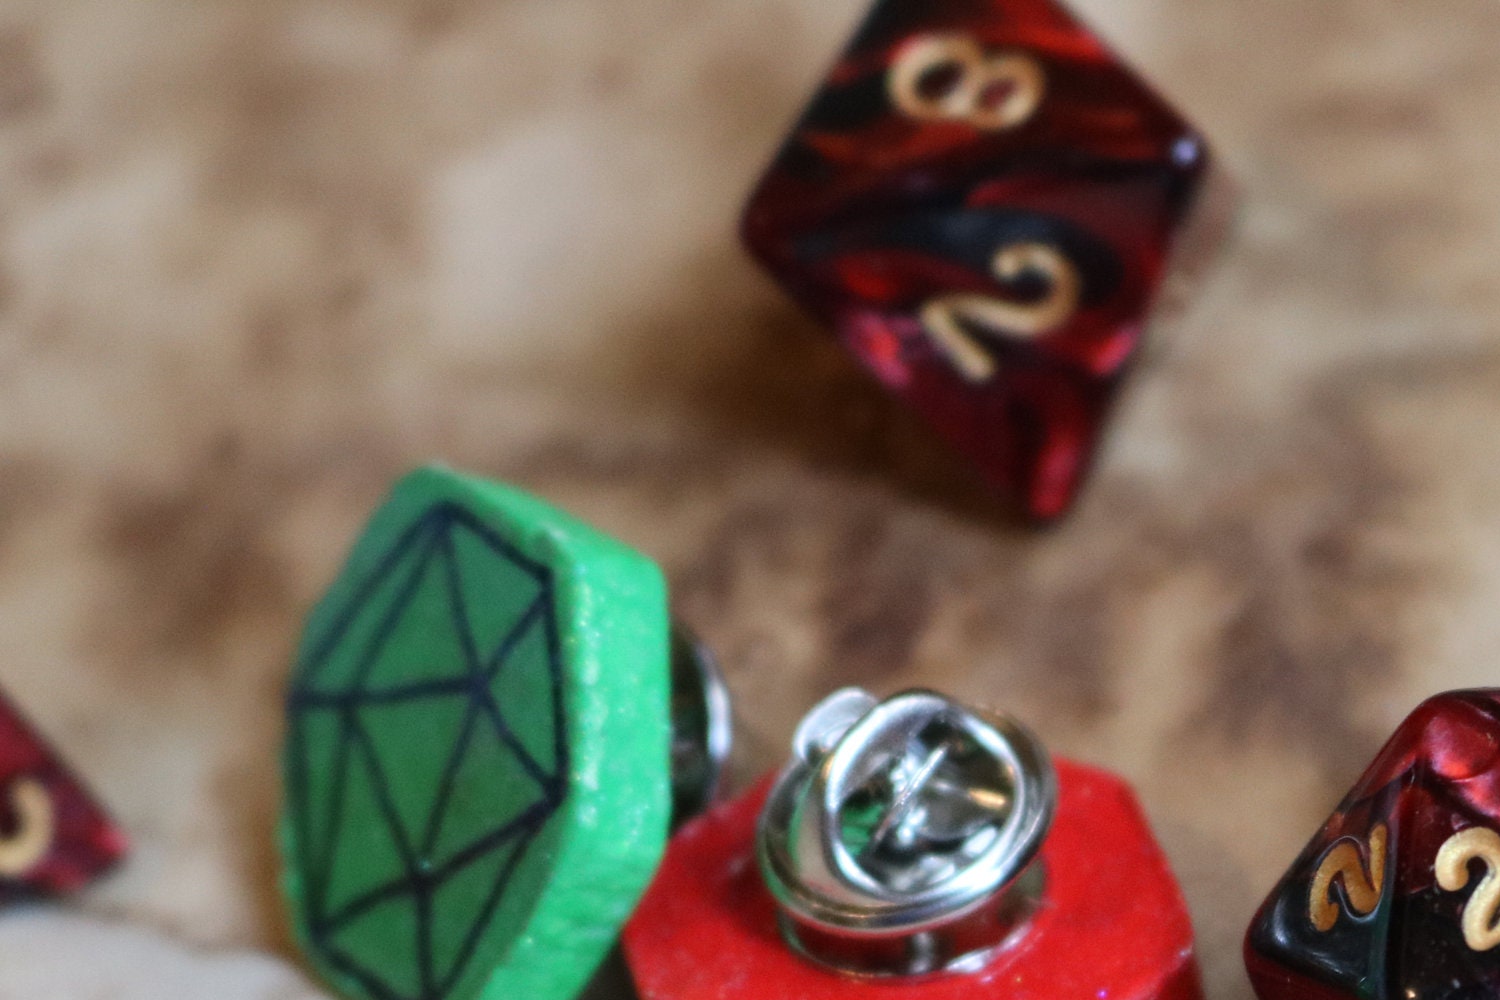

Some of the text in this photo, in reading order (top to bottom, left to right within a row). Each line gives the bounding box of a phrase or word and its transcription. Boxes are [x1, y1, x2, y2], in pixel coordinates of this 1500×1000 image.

[887, 35, 1046, 131] 8
[919, 242, 1082, 383] 2
[1309, 823, 1387, 932] 2
